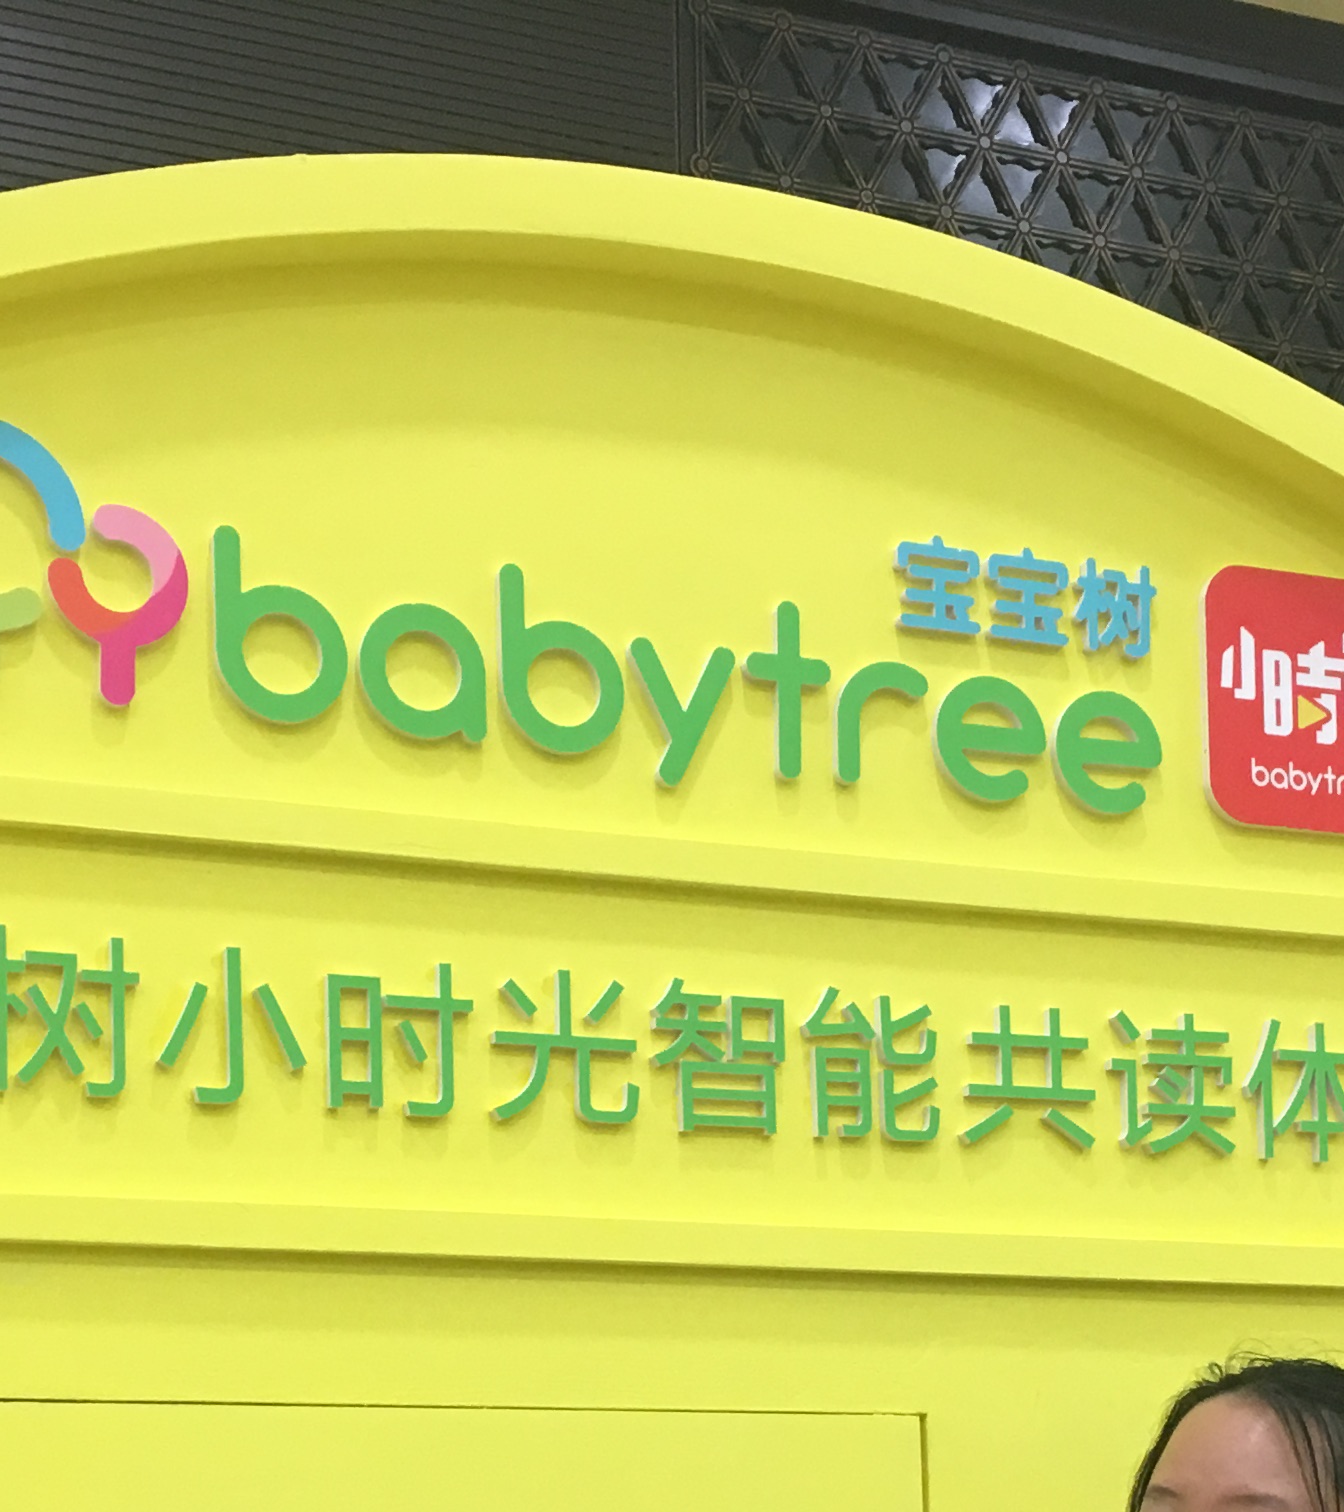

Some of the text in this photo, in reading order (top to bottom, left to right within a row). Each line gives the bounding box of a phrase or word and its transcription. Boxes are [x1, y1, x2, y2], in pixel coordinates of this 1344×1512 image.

[211, 524, 1164, 815] babytree
[895, 535, 1158, 659] 宝宝树
